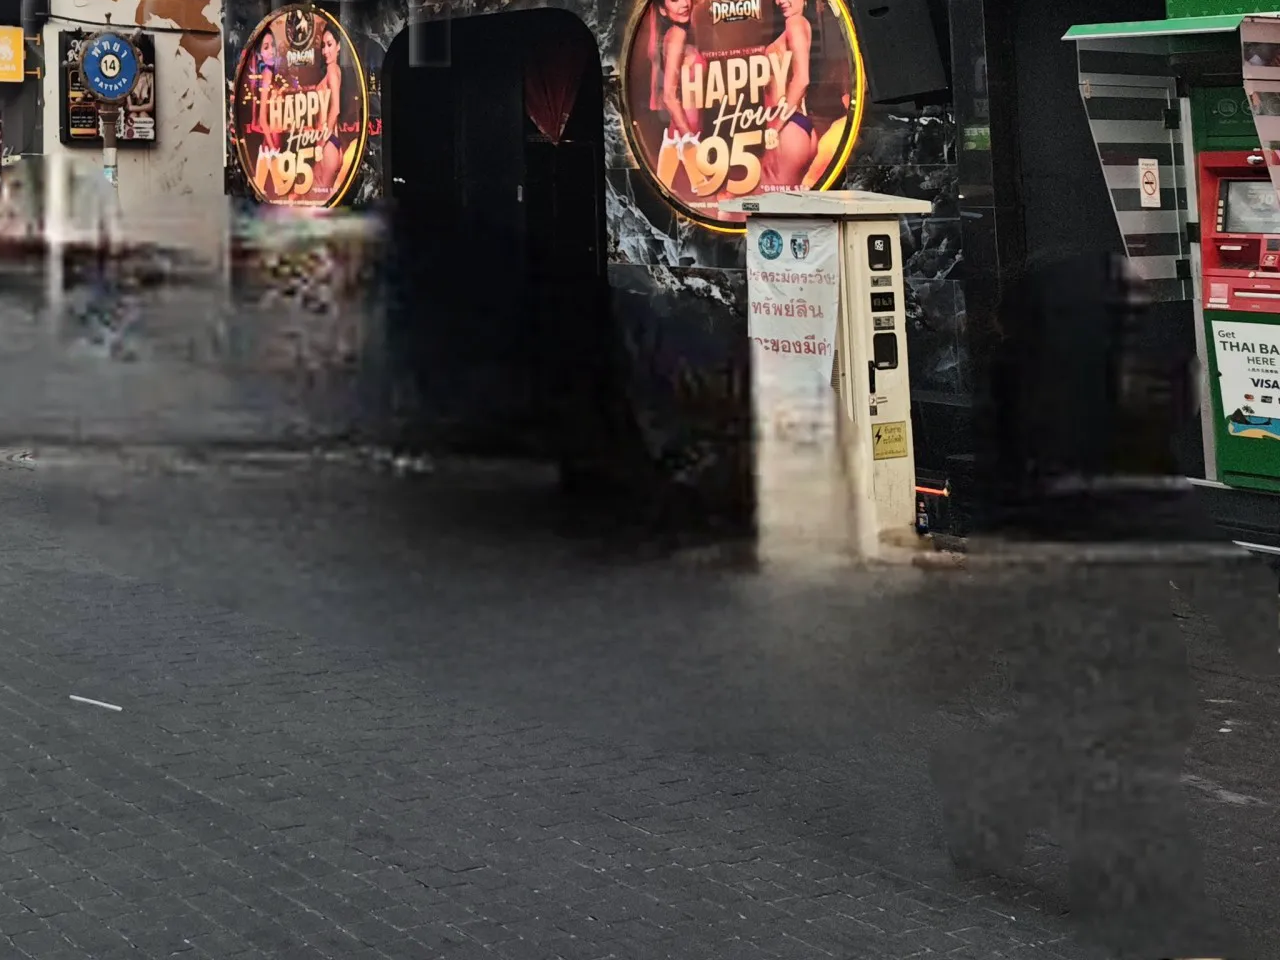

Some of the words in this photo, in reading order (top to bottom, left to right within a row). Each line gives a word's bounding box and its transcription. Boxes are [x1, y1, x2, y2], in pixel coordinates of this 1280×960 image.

[103, 59, 117, 72] 14
[286, 48, 315, 66] DRAGON
[93, 76, 128, 91] PATTAYA
[680, 50, 793, 110] HAPPY
[270, 90, 332, 133] HAPPY
[712, 93, 796, 138] Hour
[287, 121, 333, 152] Hour
[751, 297, 824, 319] ทรัพย์สิน
[1218, 329, 1236, 339] Get
[1219, 340, 1256, 354] THAI
[1259, 343, 1280, 356] BA
[1247, 355, 1277, 367] HERE
[1248, 377, 1280, 390] VISA
